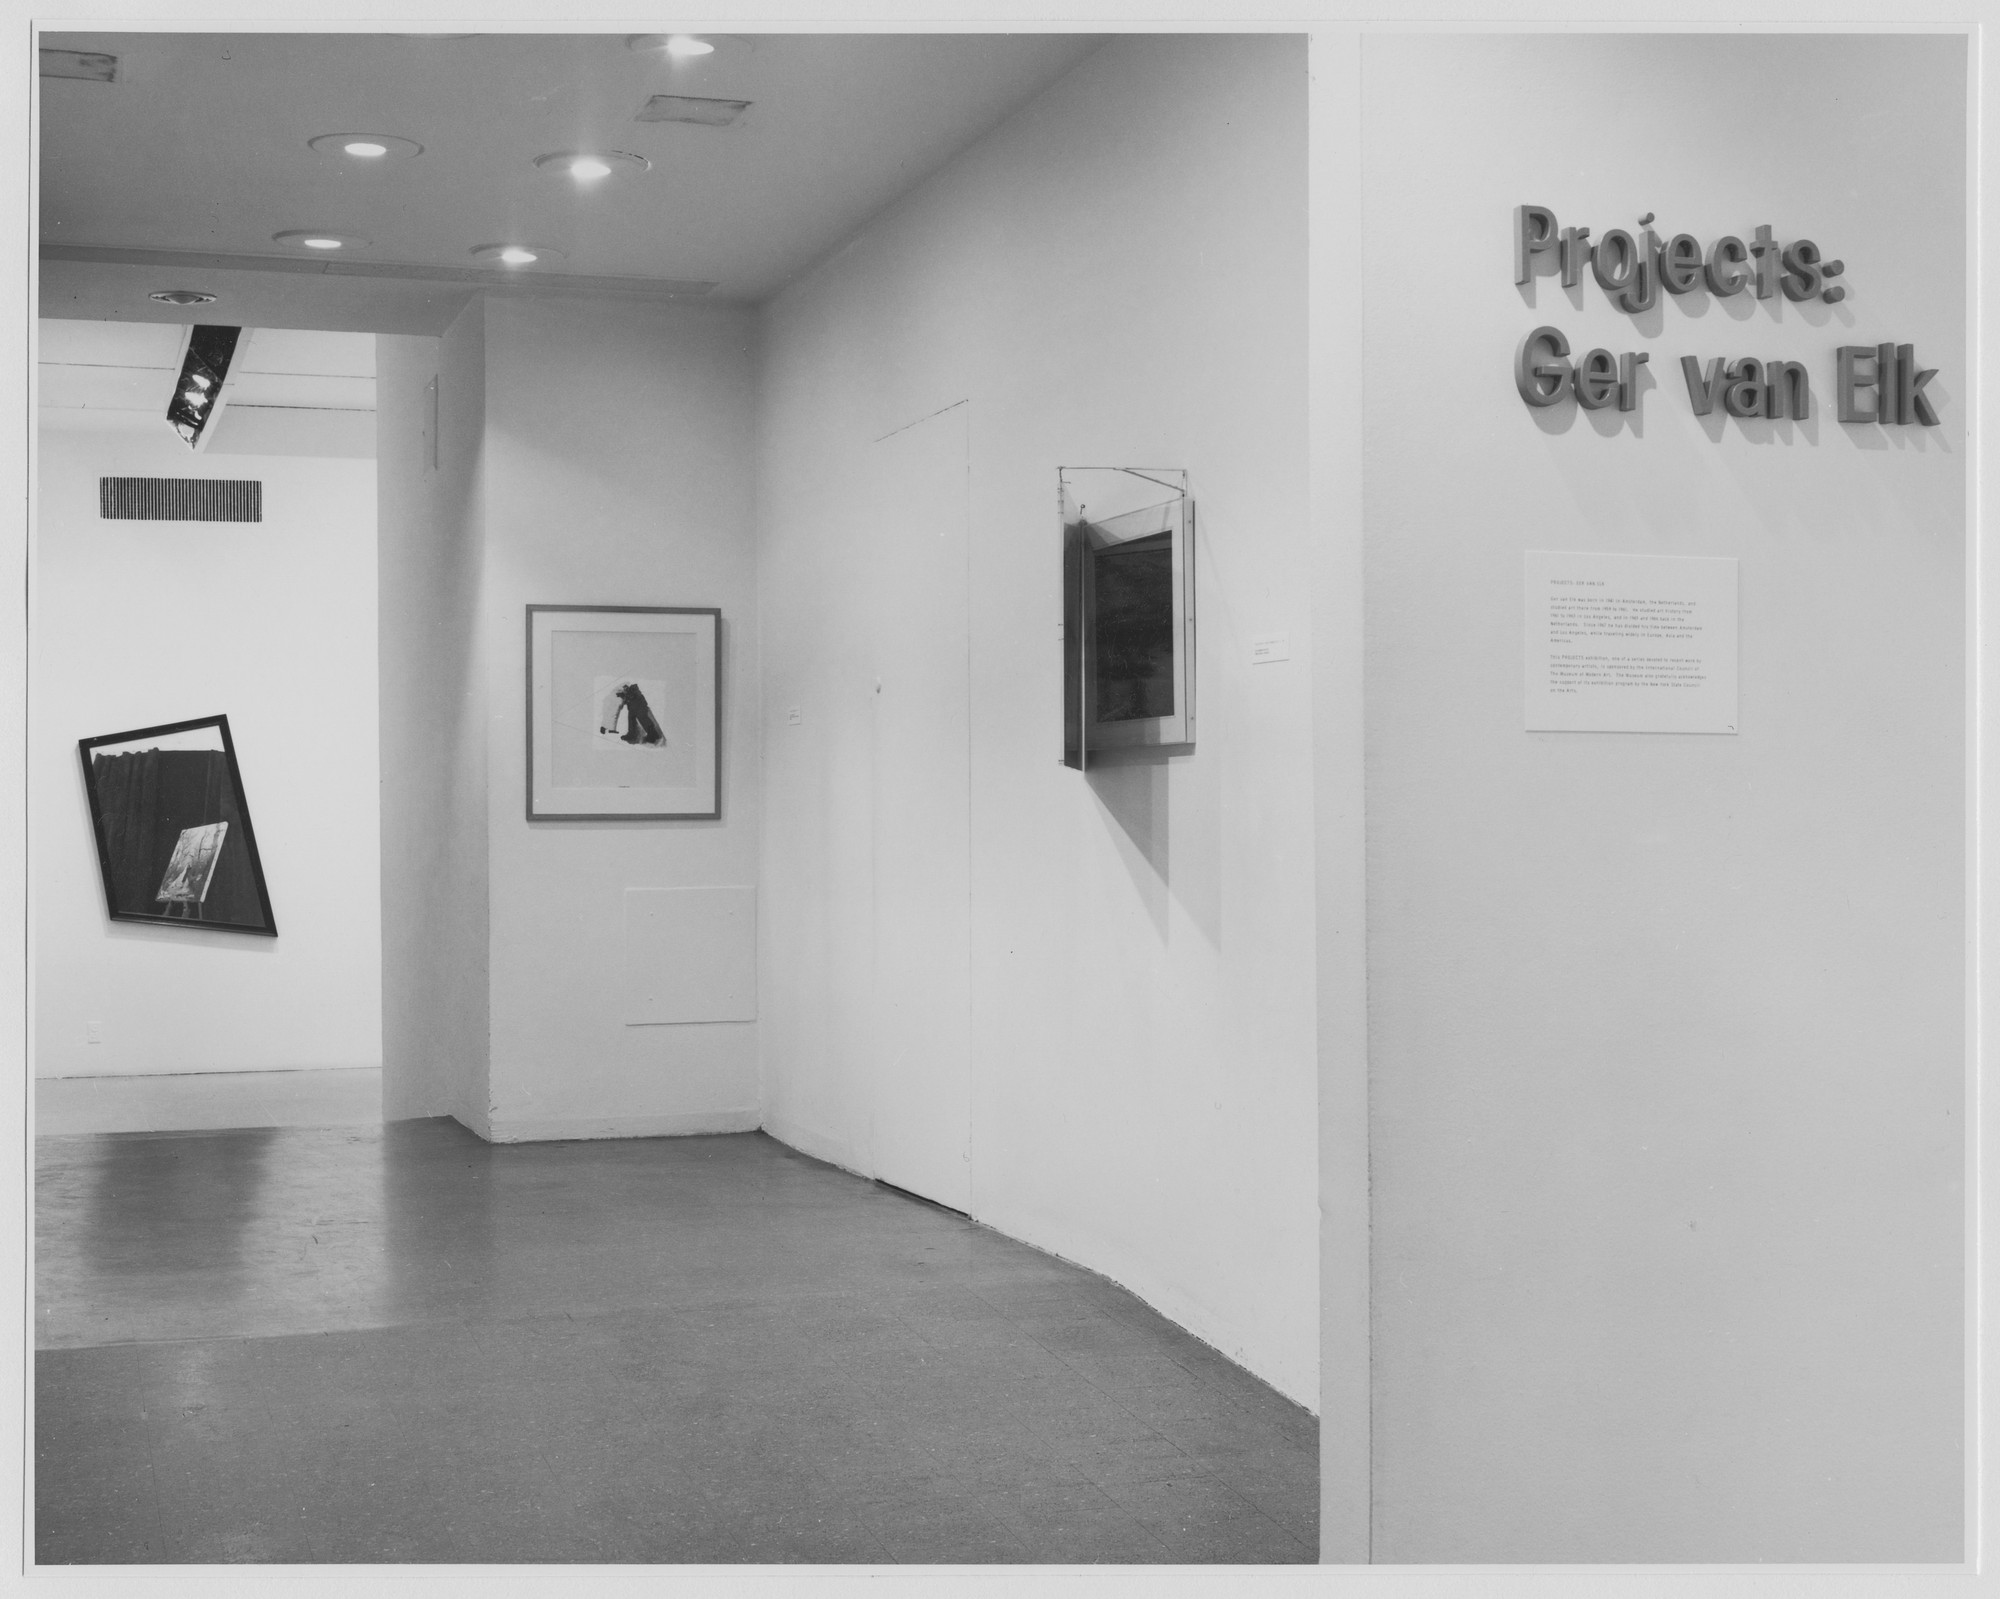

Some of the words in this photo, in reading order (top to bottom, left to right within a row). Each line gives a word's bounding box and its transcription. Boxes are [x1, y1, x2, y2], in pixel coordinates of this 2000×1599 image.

[1513, 204, 1845, 314] Projects:
[1514, 325, 1650, 412] Ger
[1680, 354, 1809, 421] van
[1836, 341, 1941, 427] Elk
